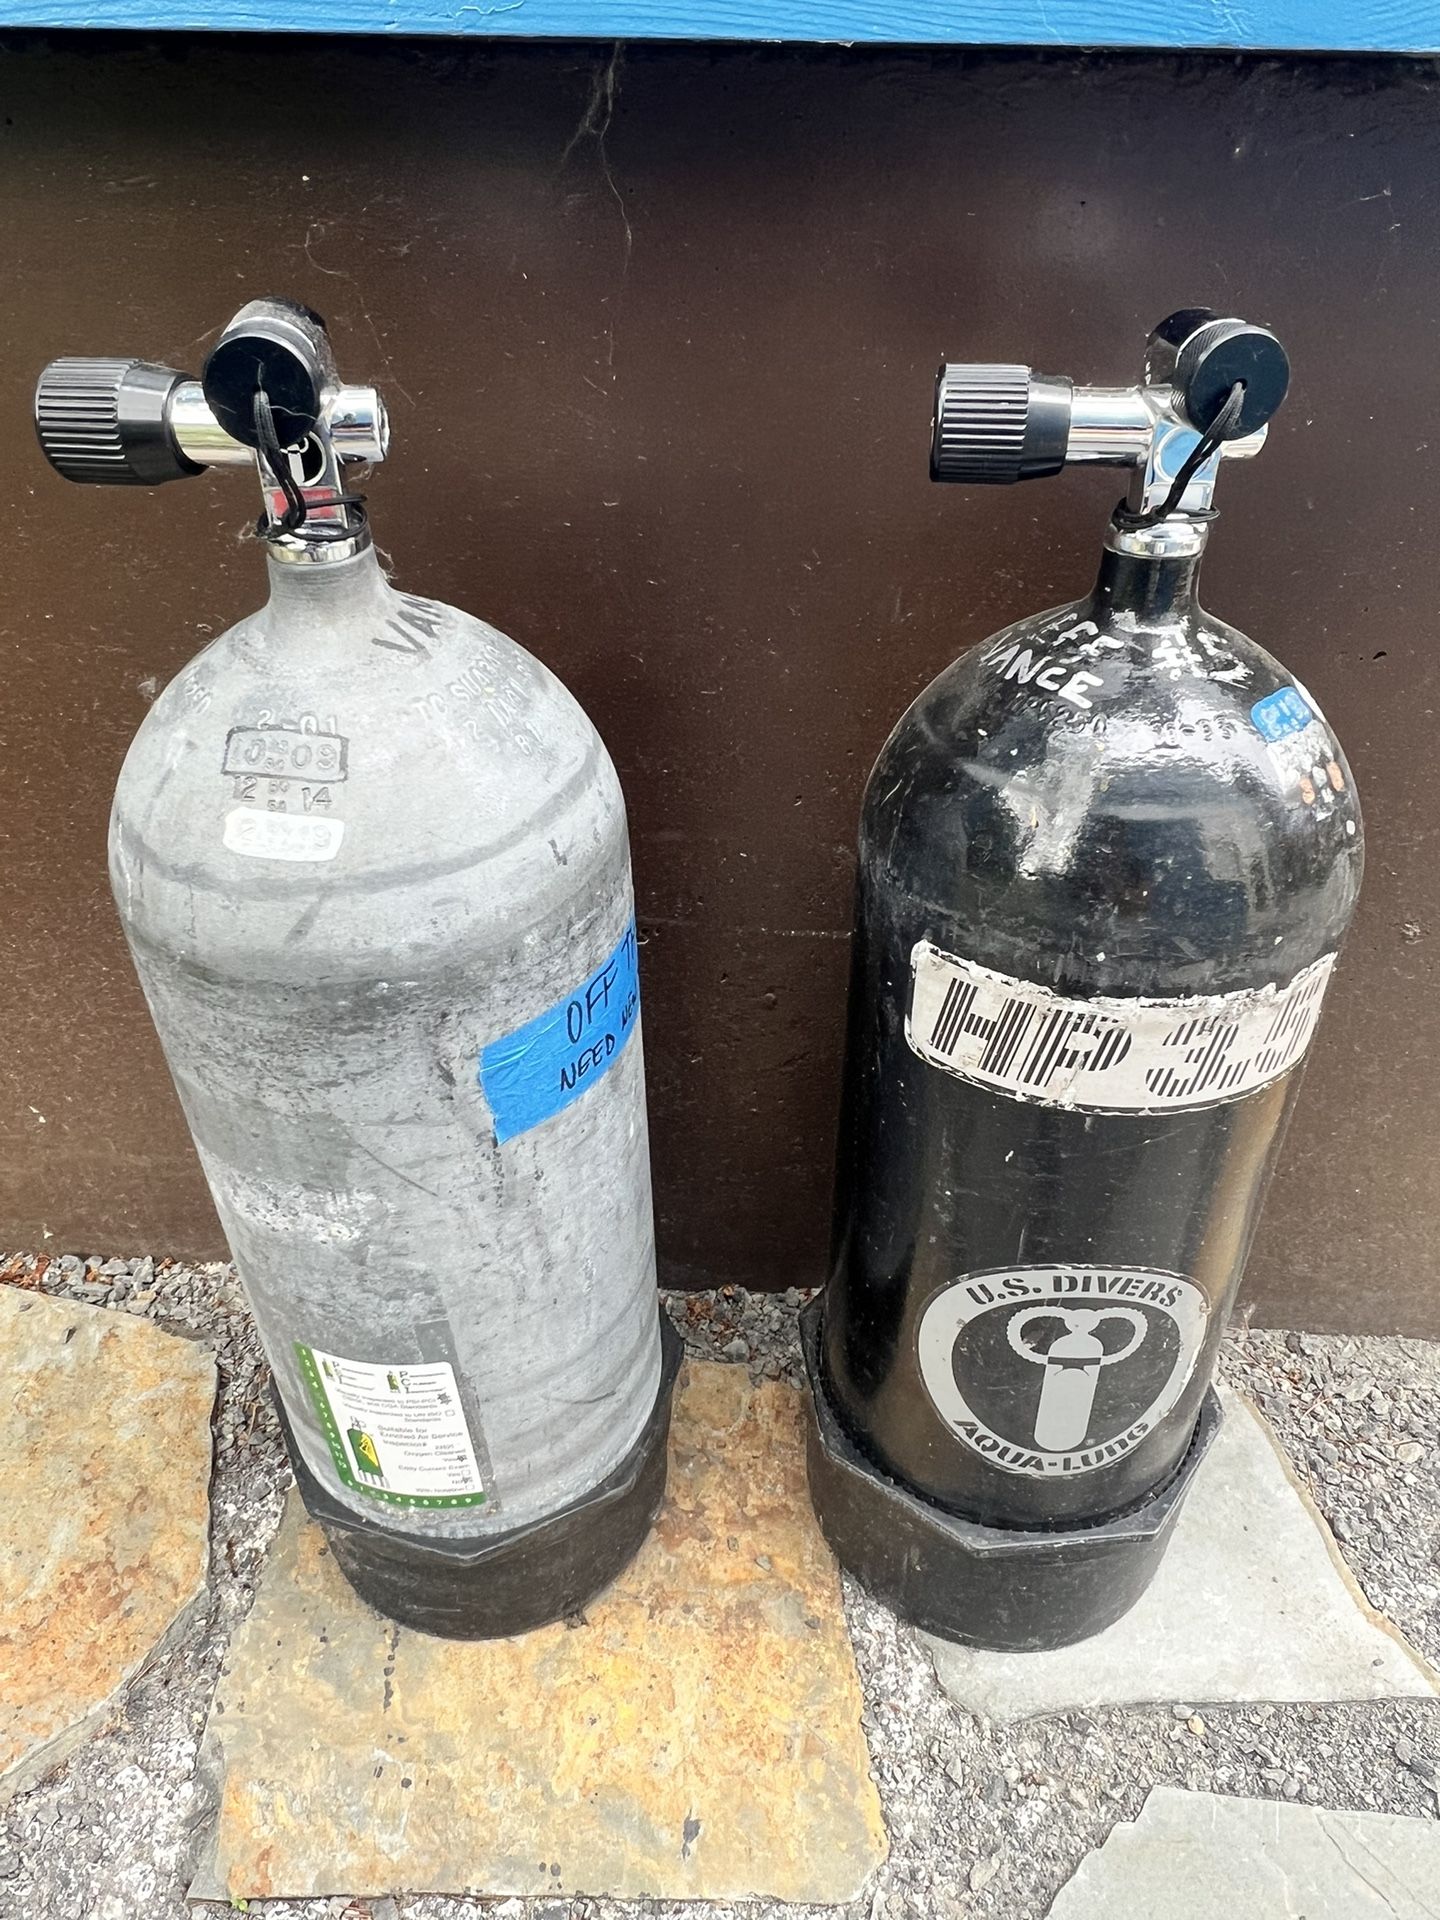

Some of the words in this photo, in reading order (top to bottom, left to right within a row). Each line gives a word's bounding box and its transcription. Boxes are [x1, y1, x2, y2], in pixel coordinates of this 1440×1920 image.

[566, 958, 619, 1044] OFF
[930, 977, 1133, 1088] HP
[560, 1033, 616, 1092] NEED
[965, 1276, 1042, 1306] U.S.
[1052, 1274, 1184, 1308] DIVERS
